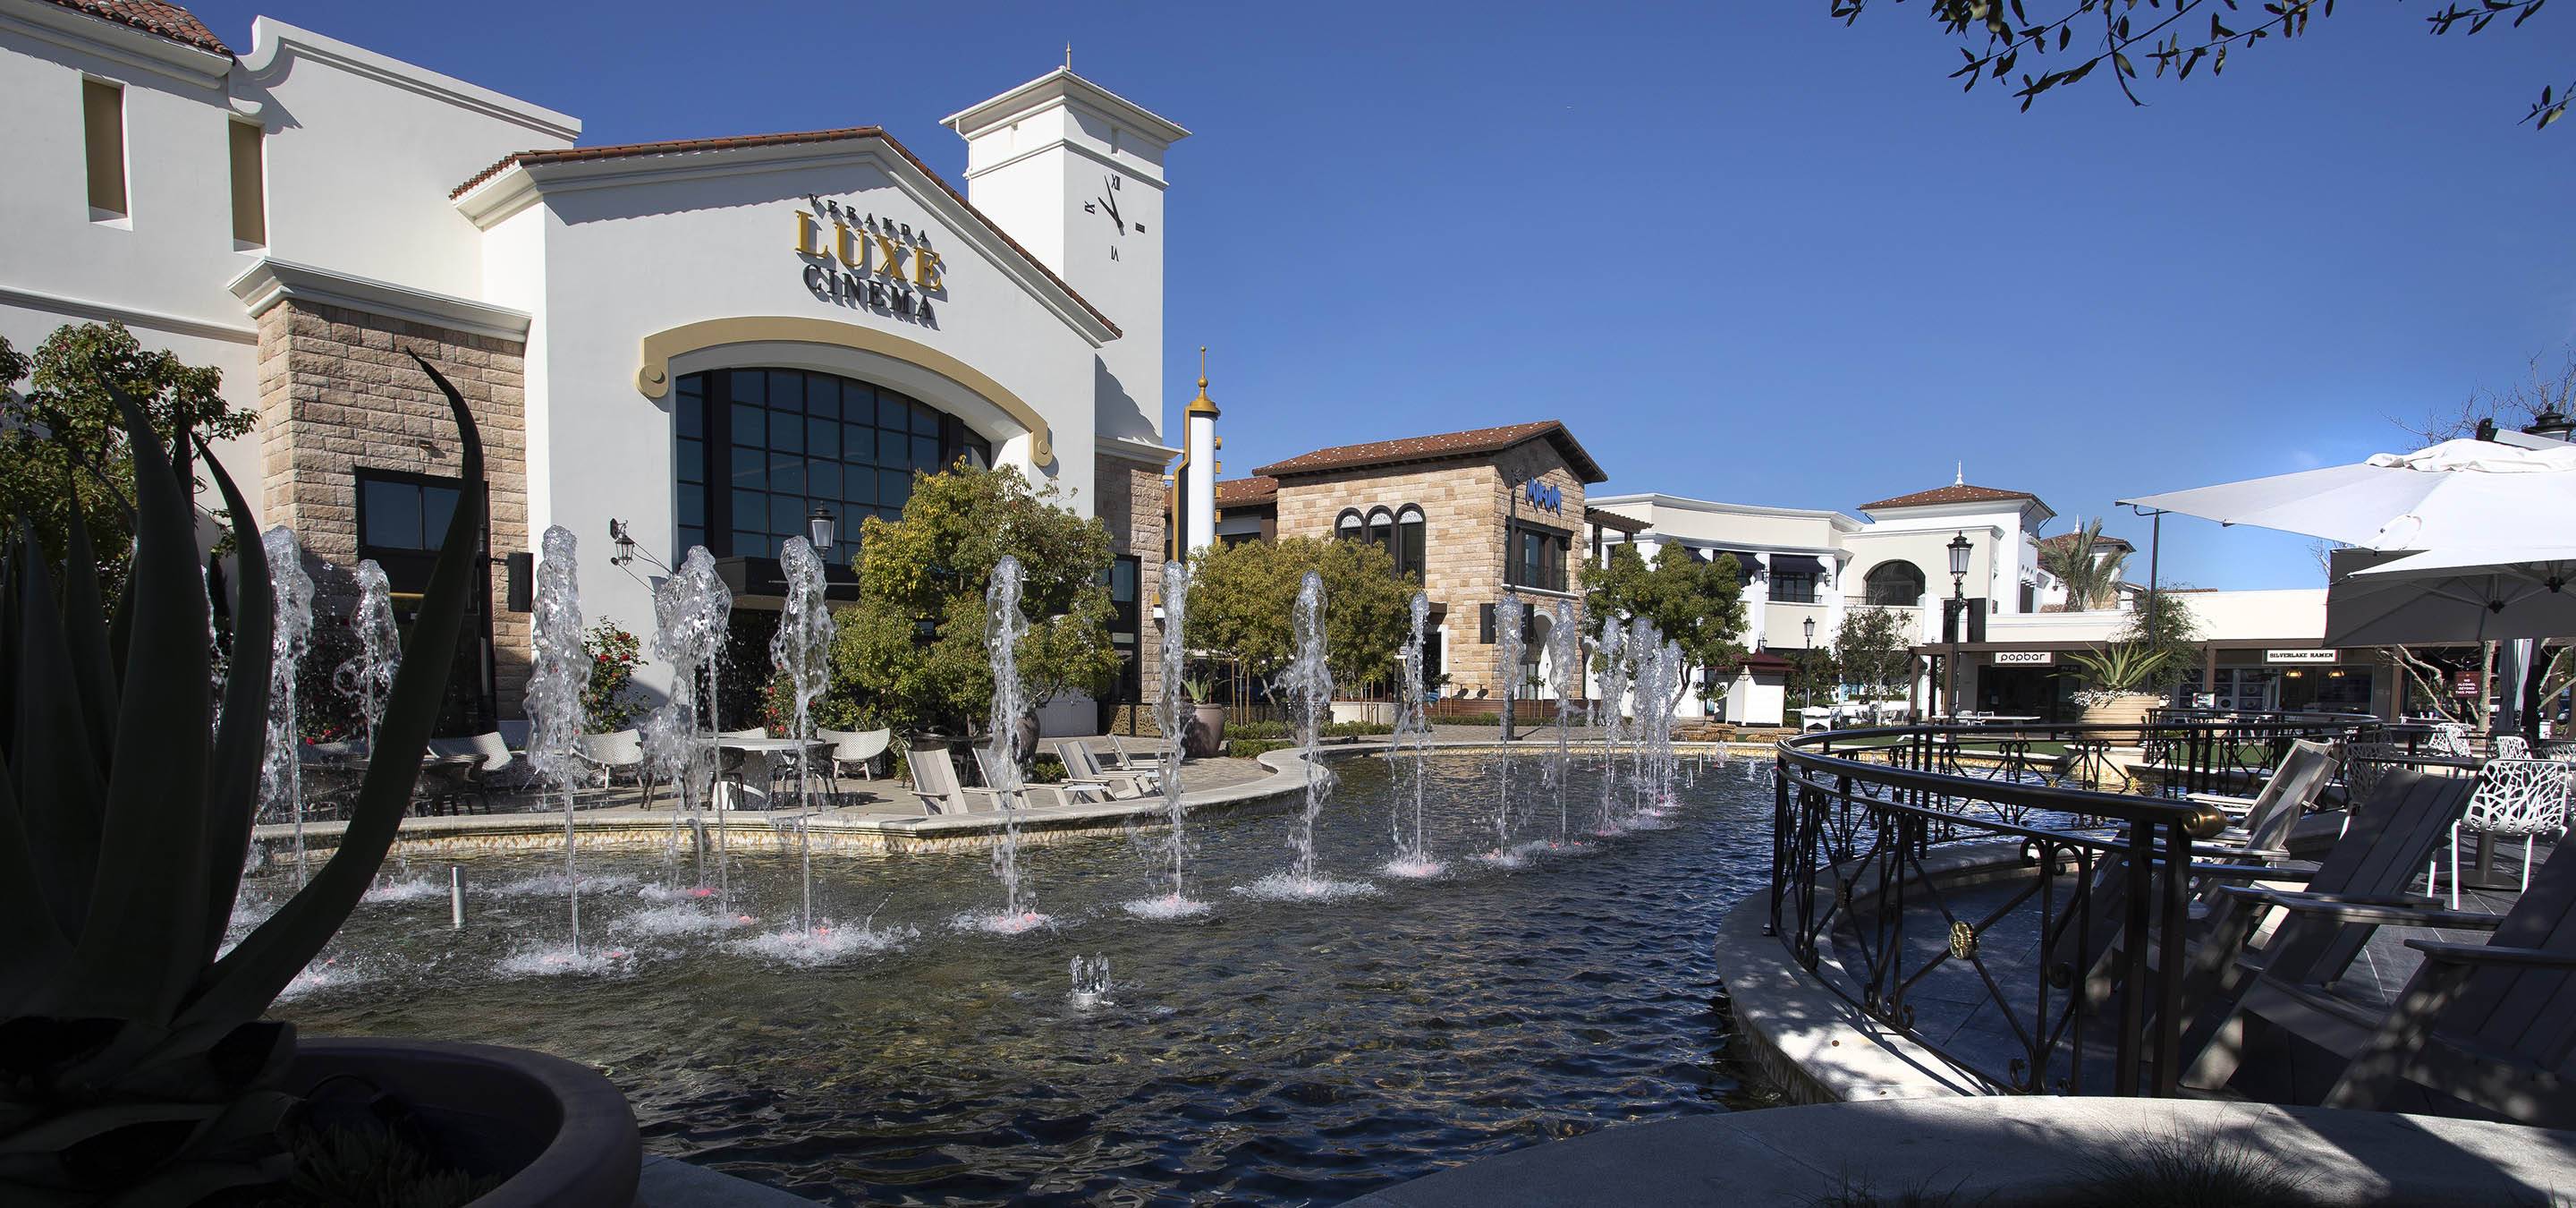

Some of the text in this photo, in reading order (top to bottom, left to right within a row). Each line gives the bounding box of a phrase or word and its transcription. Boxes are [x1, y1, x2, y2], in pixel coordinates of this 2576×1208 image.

[808, 193, 928, 242] VERANDA
[794, 209, 941, 291] LUXE
[802, 264, 933, 319] CINEMA
[2001, 652, 2046, 662] popbar
